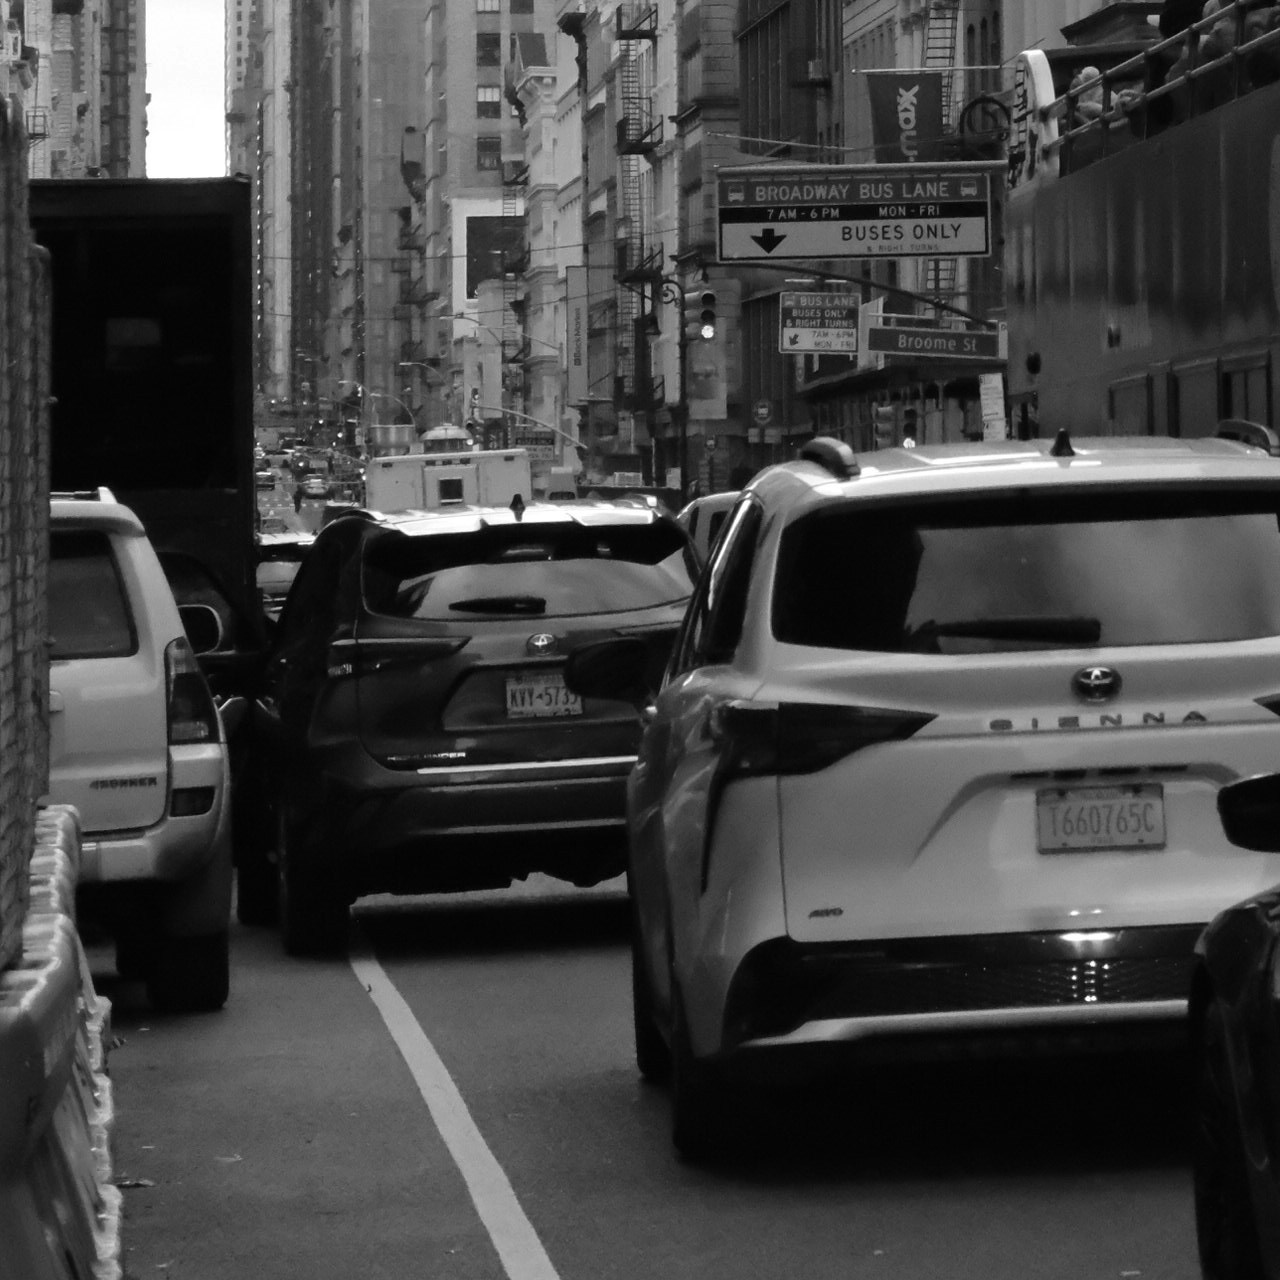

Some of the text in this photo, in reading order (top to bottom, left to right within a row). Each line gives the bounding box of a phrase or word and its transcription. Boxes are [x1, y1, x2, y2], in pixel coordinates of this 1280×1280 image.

[755, 181, 950, 201] BROADWAY BUS LANE
[767, 209, 774, 220] 7
[778, 208, 797, 220] AM
[810, 208, 818, 219] 6
[821, 207, 840, 218] PM
[878, 206, 904, 218] MON
[919, 205, 941, 216] FRI
[841, 223, 962, 242] BUSES ONLY
[800, 296, 855, 306] BUS LANE
[792, 309, 848, 317] BUSES ONLY
[795, 319, 821, 328] RIGHT
[824, 320, 854, 328] TURNS
[898, 334, 977, 352] Broome St
[989, 711, 1208, 731] SIENNA
[1049, 802, 1155, 837] T660765C
